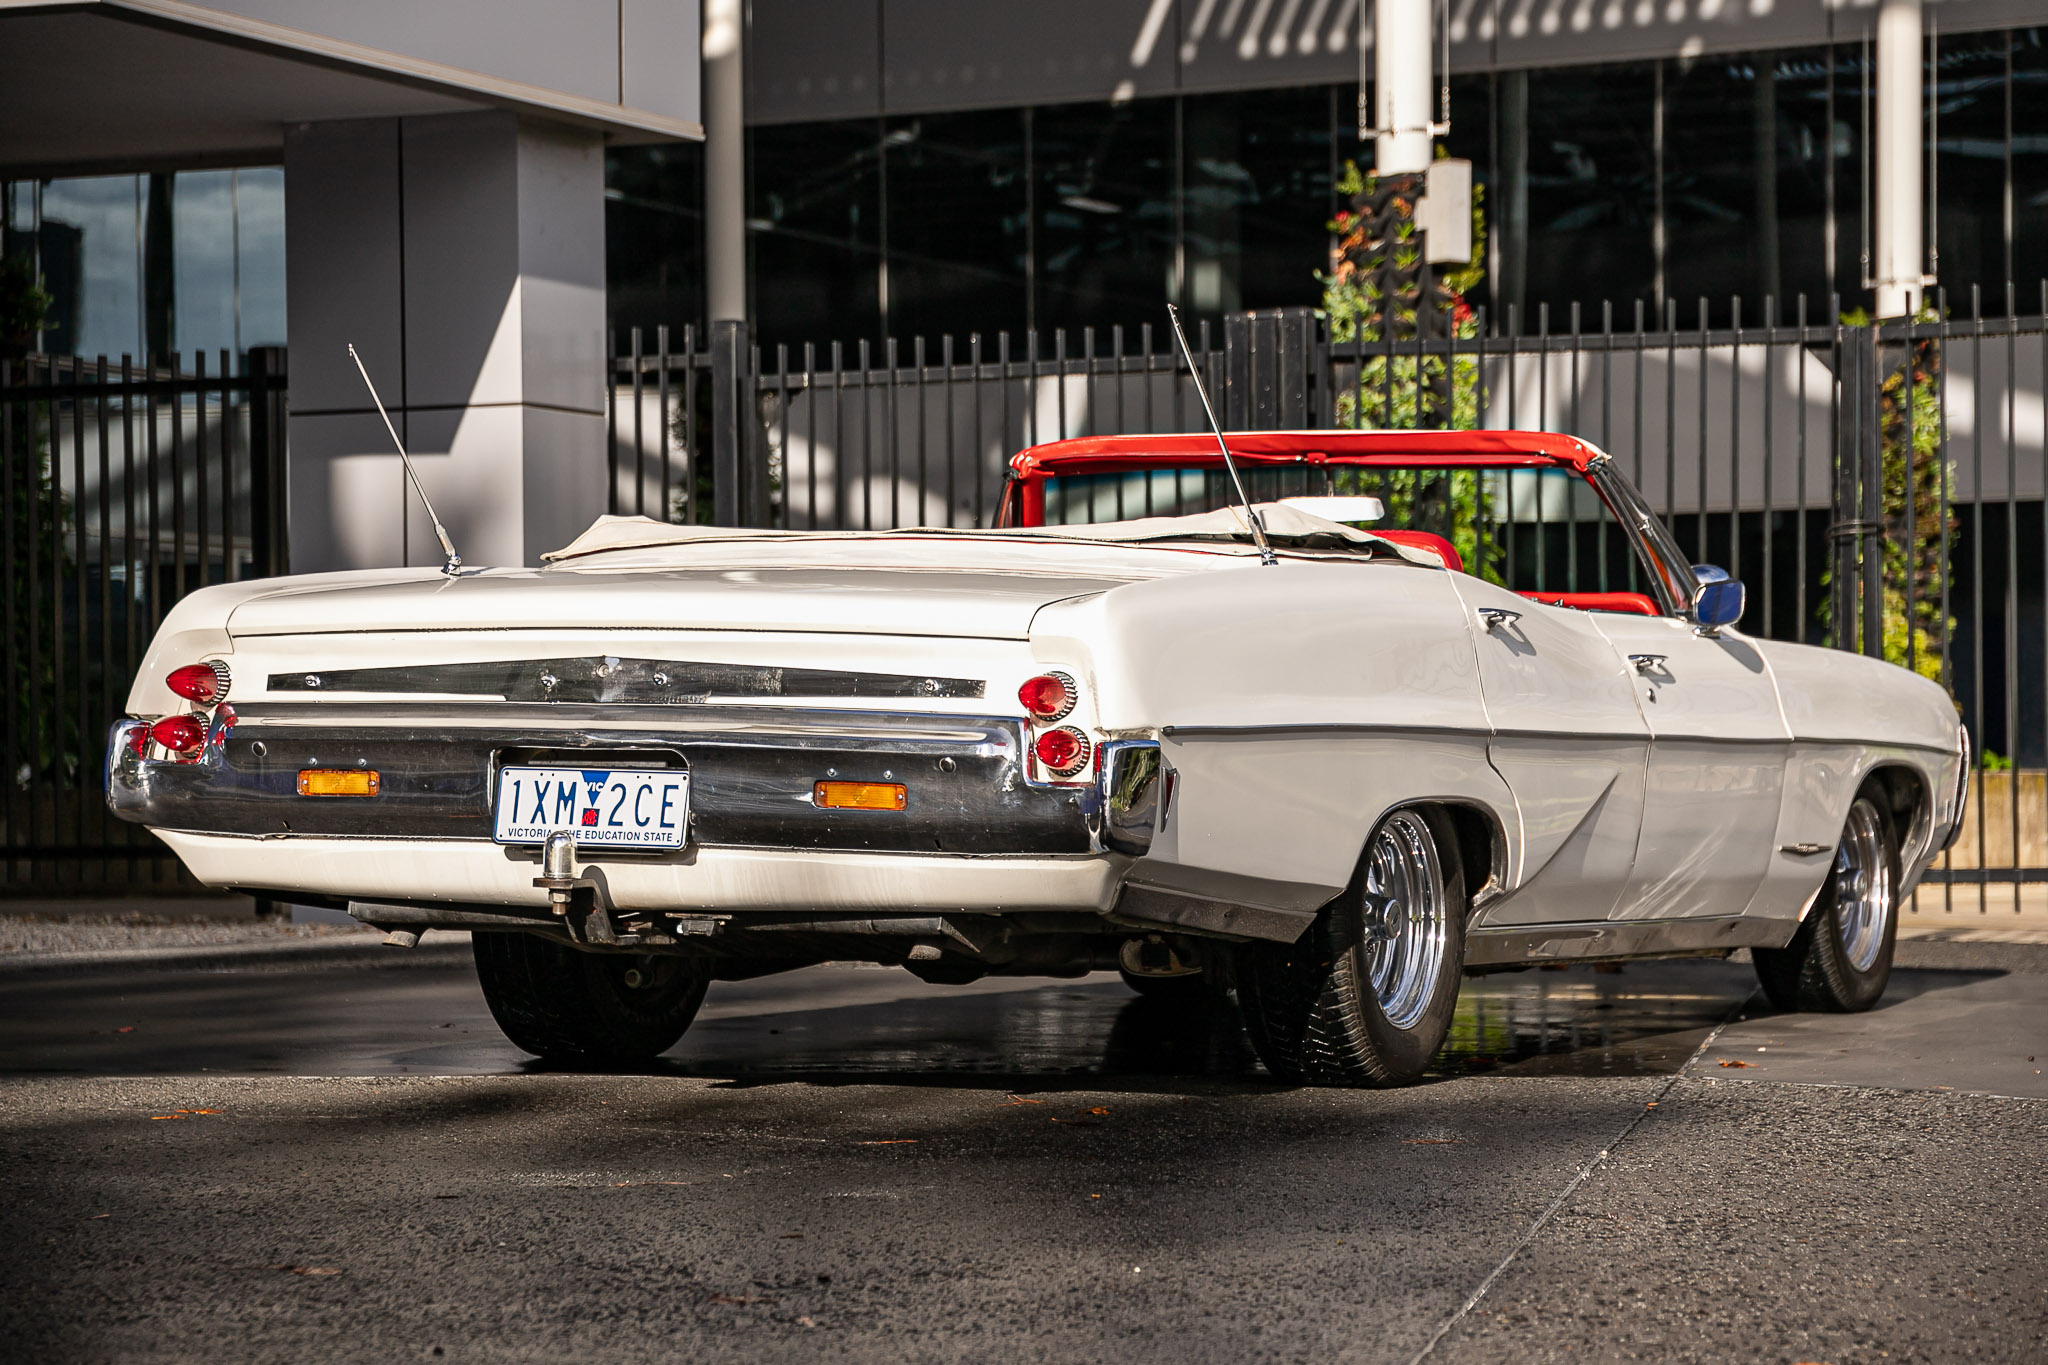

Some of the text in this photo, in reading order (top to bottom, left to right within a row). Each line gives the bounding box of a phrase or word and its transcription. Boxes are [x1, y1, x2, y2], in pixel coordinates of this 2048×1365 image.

[584, 781, 604, 792] VIC
[513, 780, 679, 828] 1XM 2CE
[584, 830, 640, 841] EDUCATION
[644, 832, 673, 842] STATE
